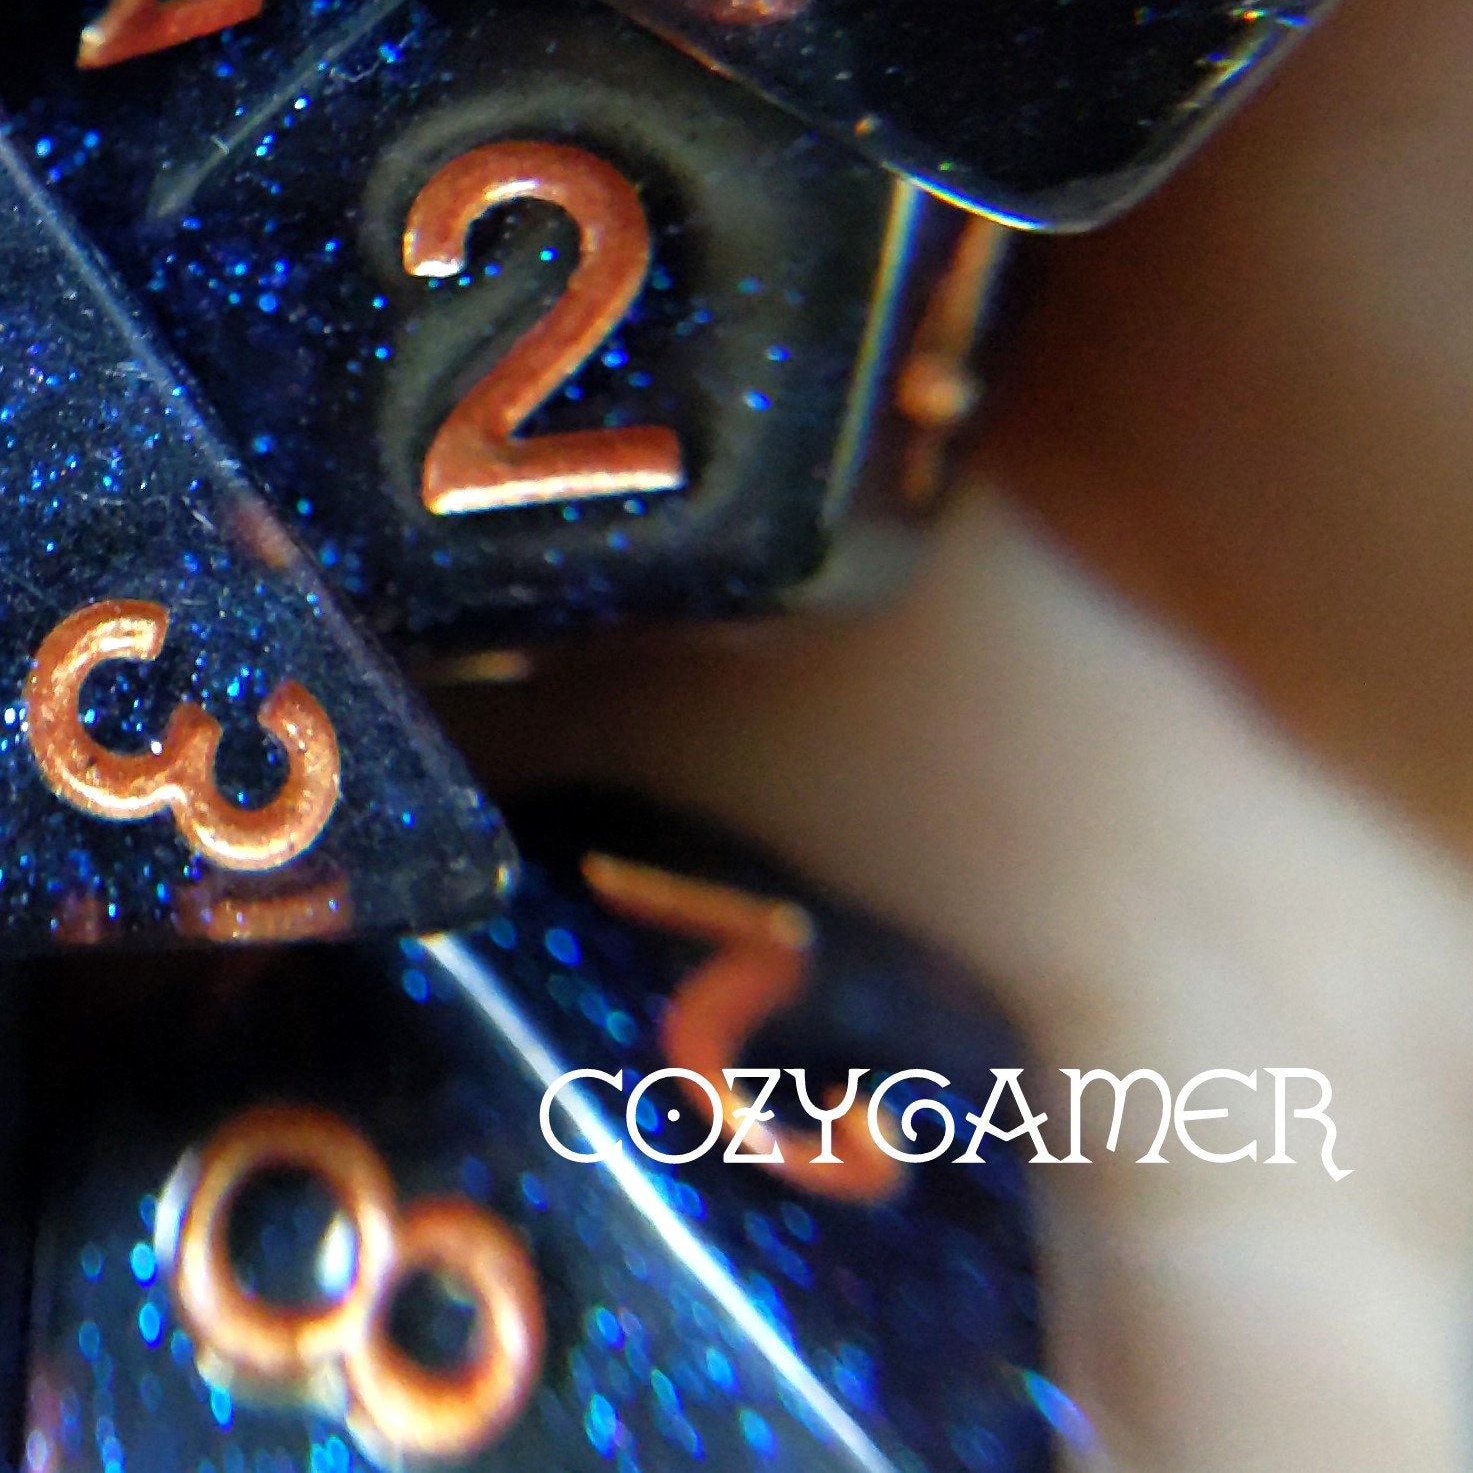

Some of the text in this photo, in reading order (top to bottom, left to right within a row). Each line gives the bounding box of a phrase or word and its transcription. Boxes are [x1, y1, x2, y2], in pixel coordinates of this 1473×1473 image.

[401, 140, 686, 515] 2
[28, 597, 341, 872] 3
[170, 1100, 544, 1467] 8
